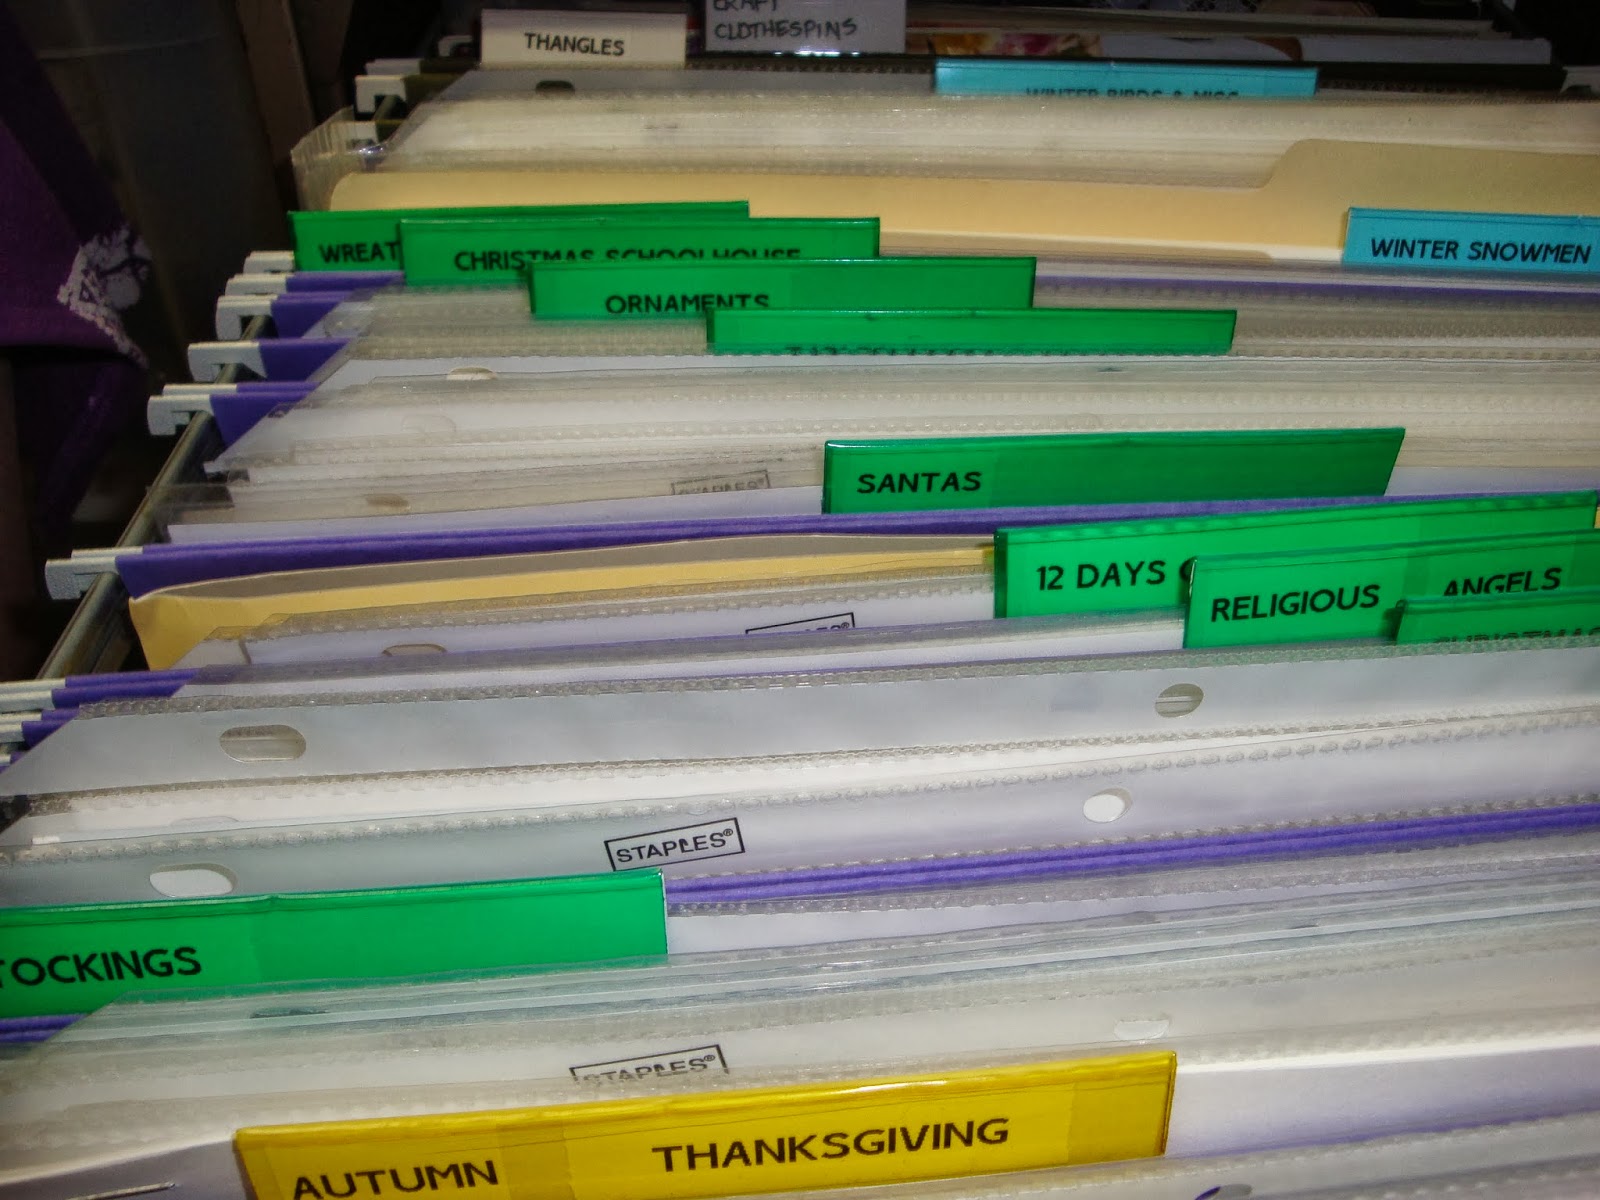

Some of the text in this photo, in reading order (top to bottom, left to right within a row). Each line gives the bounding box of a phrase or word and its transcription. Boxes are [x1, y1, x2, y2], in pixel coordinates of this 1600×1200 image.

[713, 17, 857, 40] CLOTHESPINS
[524, 32, 625, 57] THANGLES
[1371, 238, 1592, 264] WINTER SNOWMEN
[605, 294, 770, 314] ORNAMENTS
[857, 471, 983, 494] SANTAS
[1036, 566, 1064, 591] 12
[1076, 560, 1166, 589] DAYS
[1211, 567, 1562, 623] RELIGIOUS ANGELS
[294, 1117, 1010, 1200] AUTUMN THANKSGIVING
